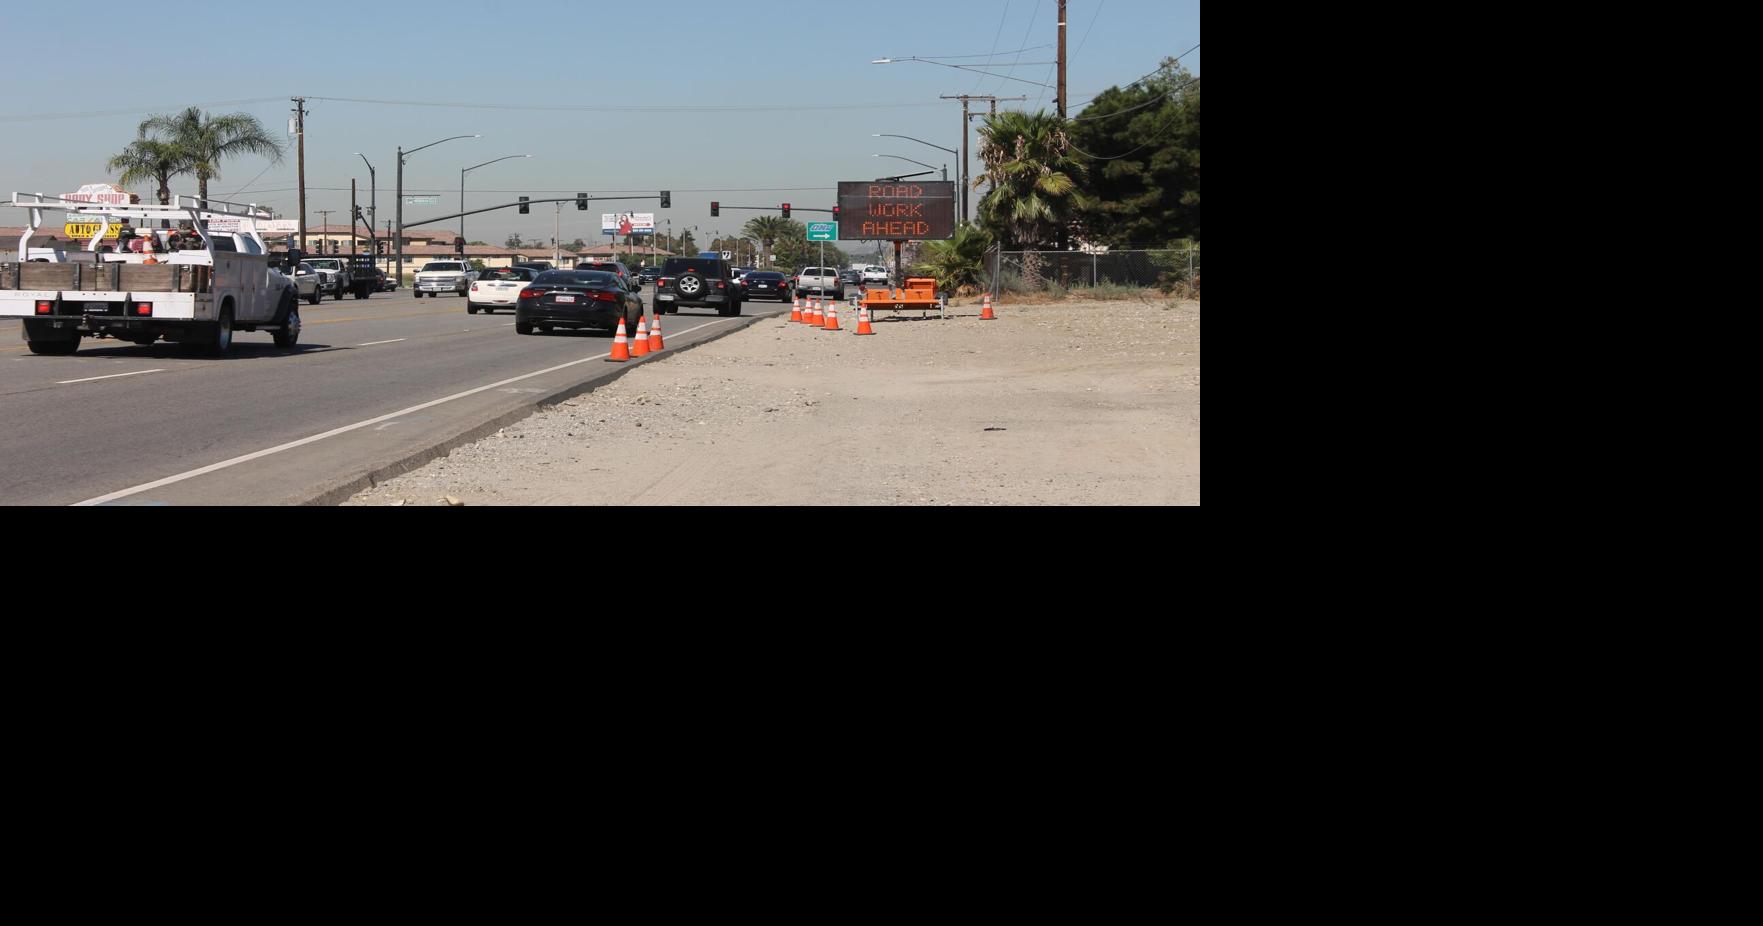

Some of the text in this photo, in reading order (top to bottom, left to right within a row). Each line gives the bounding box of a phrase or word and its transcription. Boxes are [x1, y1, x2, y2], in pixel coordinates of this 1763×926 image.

[869, 185, 922, 198] ROAD
[65, 193, 125, 204] BODY SHOP
[869, 203, 922, 217] WORK
[70, 224, 120, 234] AUTO GLSS
[863, 221, 929, 235] AHEAD
